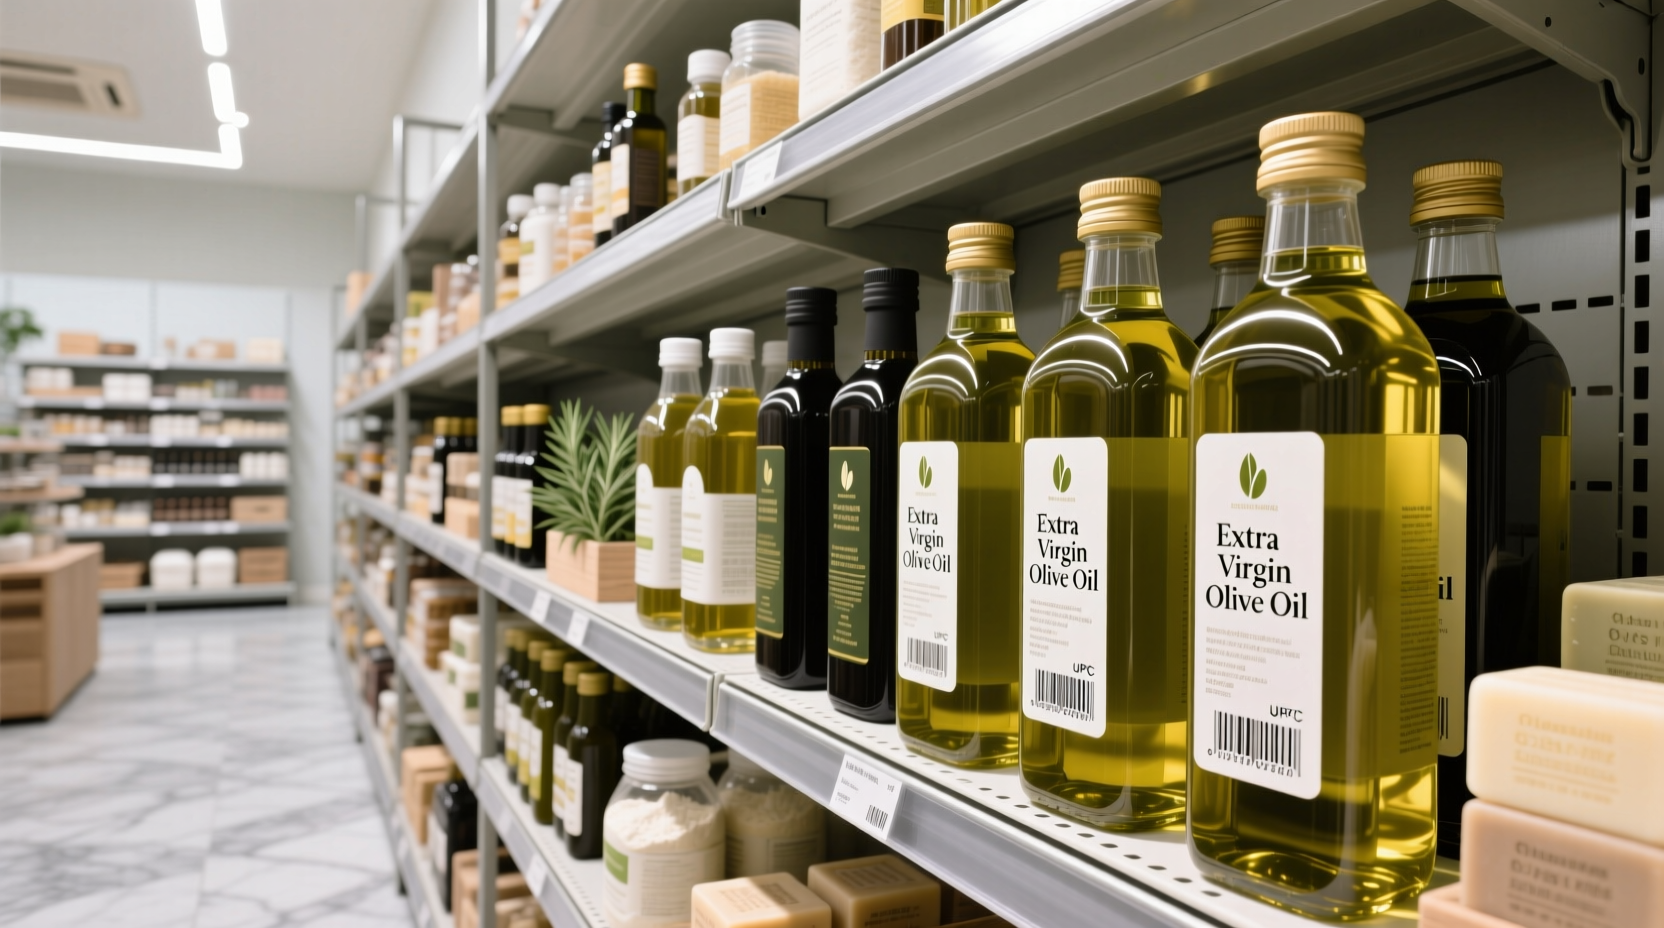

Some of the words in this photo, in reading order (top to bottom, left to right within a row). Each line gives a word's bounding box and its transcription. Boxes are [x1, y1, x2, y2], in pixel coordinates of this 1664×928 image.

[908, 506, 938, 525] Extra
[1037, 513, 1079, 535] Extra
[909, 527, 944, 552] Virgin
[1216, 522, 1279, 551] Extra
[902, 550, 931, 570] Olive
[932, 553, 951, 573] Oil
[1037, 538, 1088, 568] Virgin
[1029, 563, 1069, 588] Olive
[1072, 568, 1099, 591] Oil
[1217, 553, 1292, 589] Virgin
[1438, 576, 1453, 600] il
[1205, 584, 1264, 614] Olive
[1270, 591, 1308, 620] Oil
[1072, 662, 1095, 677] UPC
